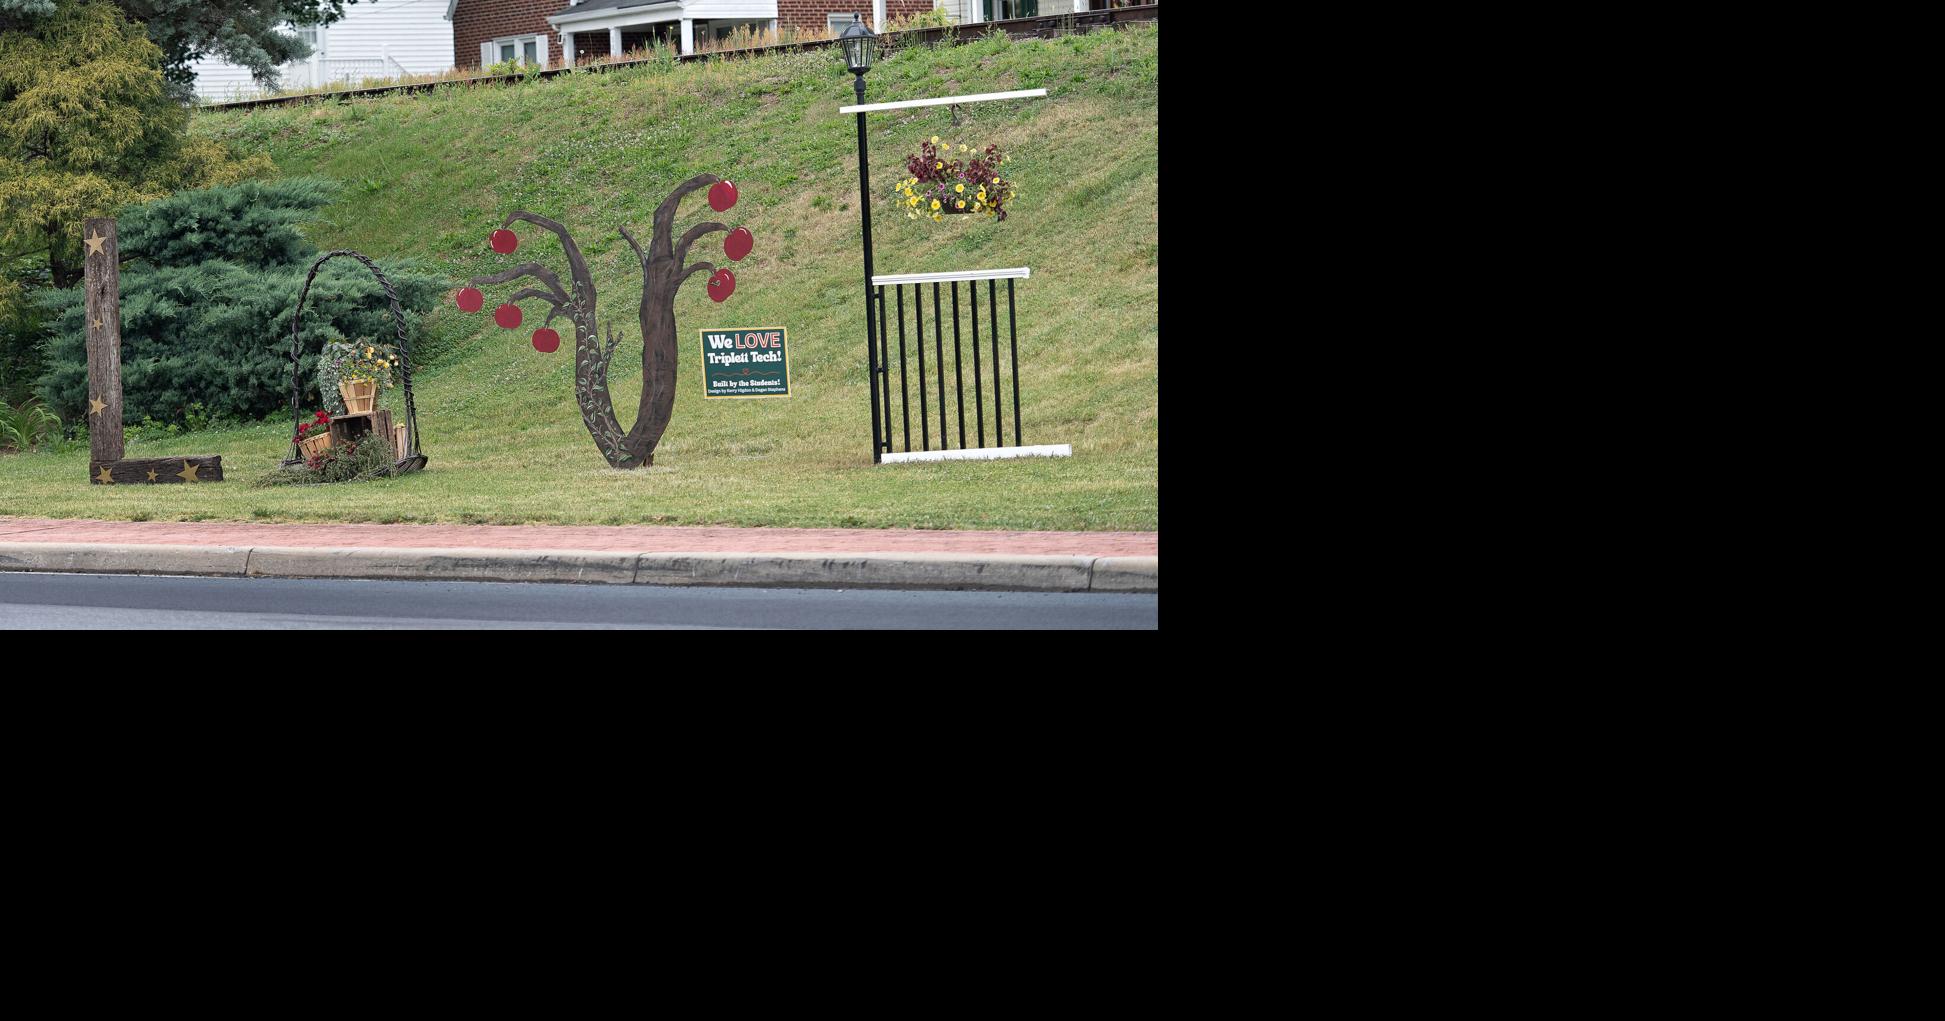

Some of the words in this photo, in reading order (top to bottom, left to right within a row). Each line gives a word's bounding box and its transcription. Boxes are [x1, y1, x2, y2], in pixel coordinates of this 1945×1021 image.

[707, 334, 733, 349] We
[735, 332, 781, 349] LOVE
[707, 352, 749, 366] Triplett
[750, 350, 782, 362] Tech!
[729, 380, 737, 388] by
